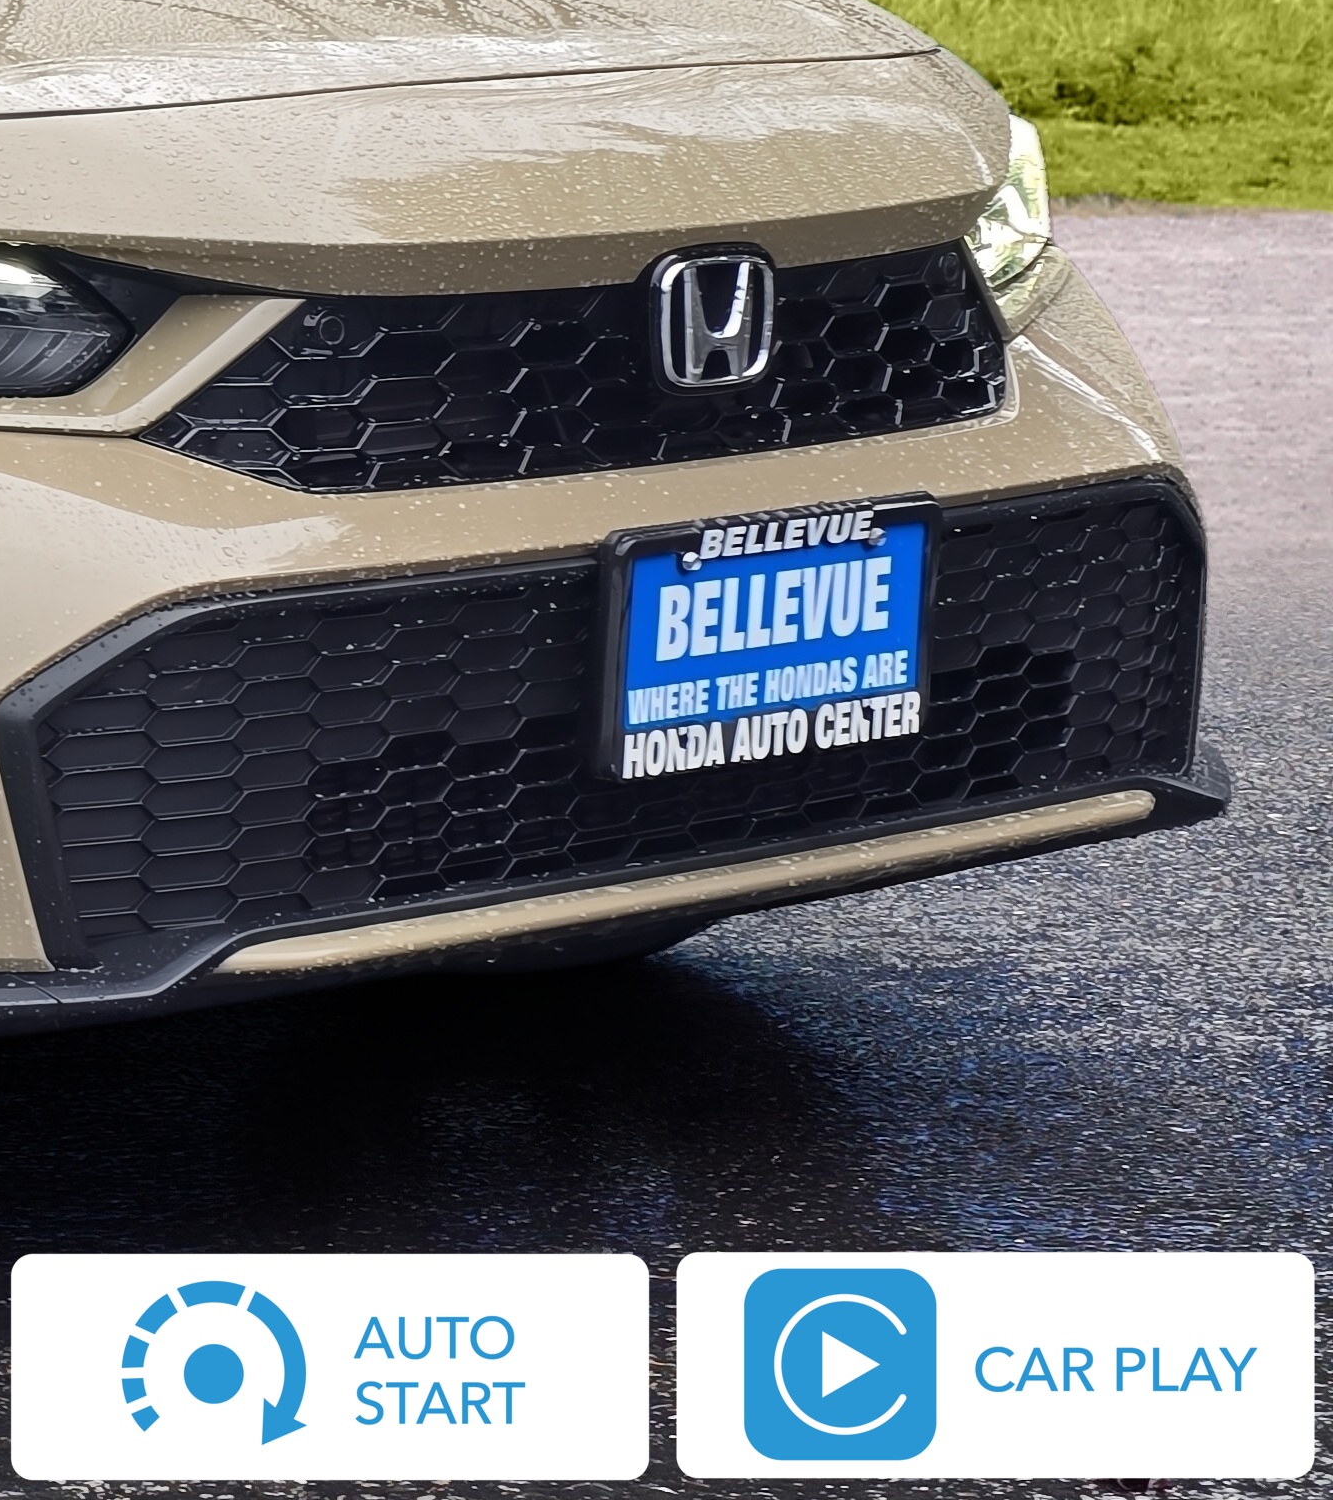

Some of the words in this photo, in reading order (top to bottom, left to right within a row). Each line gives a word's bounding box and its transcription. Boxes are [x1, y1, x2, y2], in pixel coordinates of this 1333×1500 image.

[699, 510, 875, 560] BELLEVUE
[656, 556, 893, 662] BELLEVUE
[628, 679, 710, 725] WHERE
[715, 672, 760, 711] THE
[763, 656, 858, 704] HONDAS
[862, 650, 909, 689] ARE
[622, 722, 725, 779] HONDA
[730, 708, 809, 763] AUTO
[814, 691, 921, 749] CENTER
